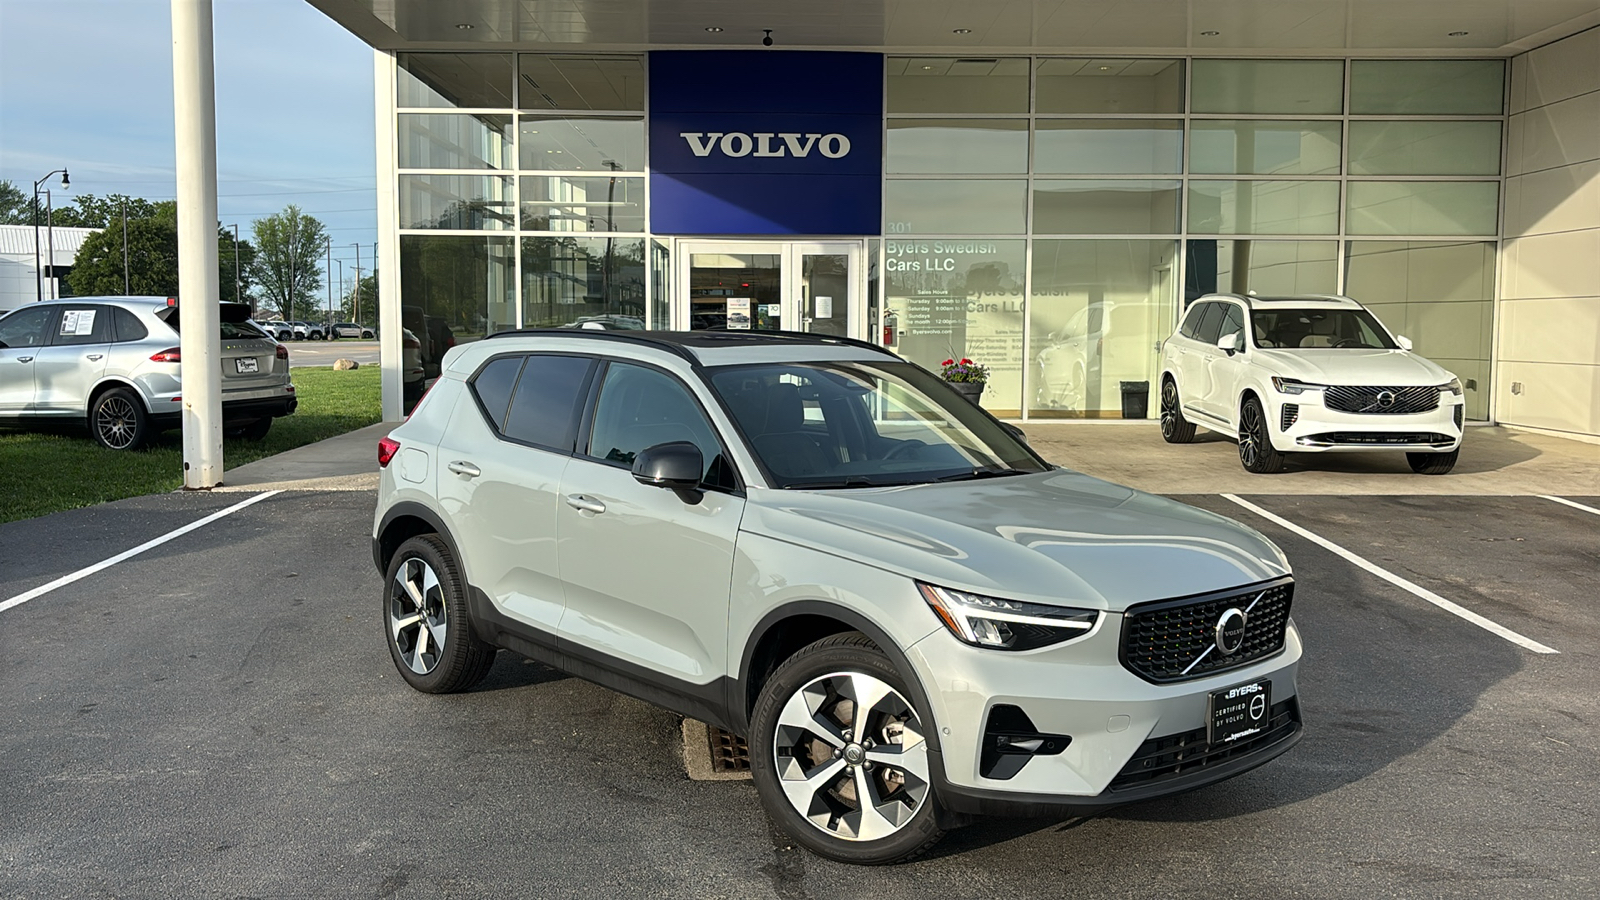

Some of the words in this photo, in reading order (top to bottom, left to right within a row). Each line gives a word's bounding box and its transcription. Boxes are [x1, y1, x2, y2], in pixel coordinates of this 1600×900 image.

[680, 132, 851, 158] VOLVO
[888, 222, 912, 234] 301
[886, 241, 929, 257] Byers
[934, 241, 997, 254] Swedish
[886, 258, 921, 271] Cars
[926, 258, 955, 271] LLC
[967, 301, 998, 313] Cars
[1229, 683, 1258, 699] BYERS
[1215, 703, 1246, 717] CERTIFIED
[1225, 713, 1244, 723] VOLVO
